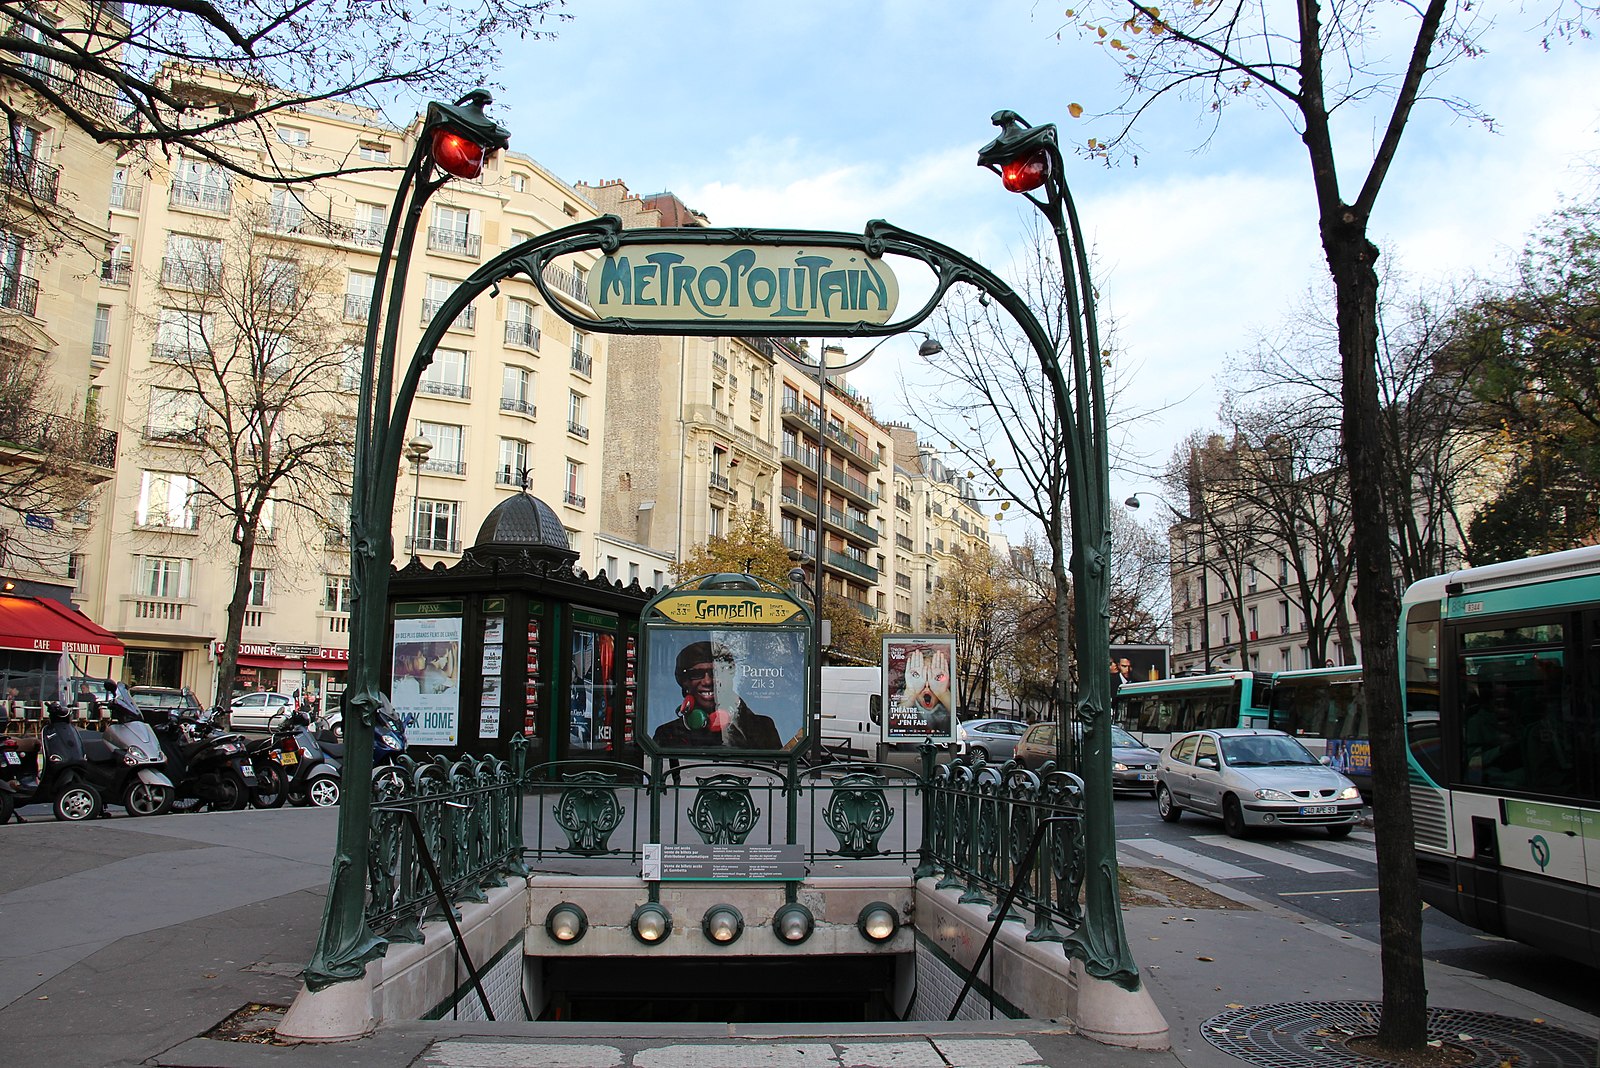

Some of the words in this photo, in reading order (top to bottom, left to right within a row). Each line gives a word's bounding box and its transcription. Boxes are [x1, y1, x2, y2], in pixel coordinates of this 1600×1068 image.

[599, 249, 888, 318] METROPOLITAIN
[418, 604, 440, 613] PRESSE
[695, 600, 763, 620] GAMBETTA
[1467, 603, 1481, 612] 8344
[61, 641, 101, 654] RESTAURANT
[741, 665, 785, 678] Parrot
[751, 679, 766, 689] Zik
[769, 679, 775, 689] 3
[424, 712, 454, 729] HOME
[1350, 755, 1367, 766] C'EST
[1562, 813, 1574, 822] Gare
